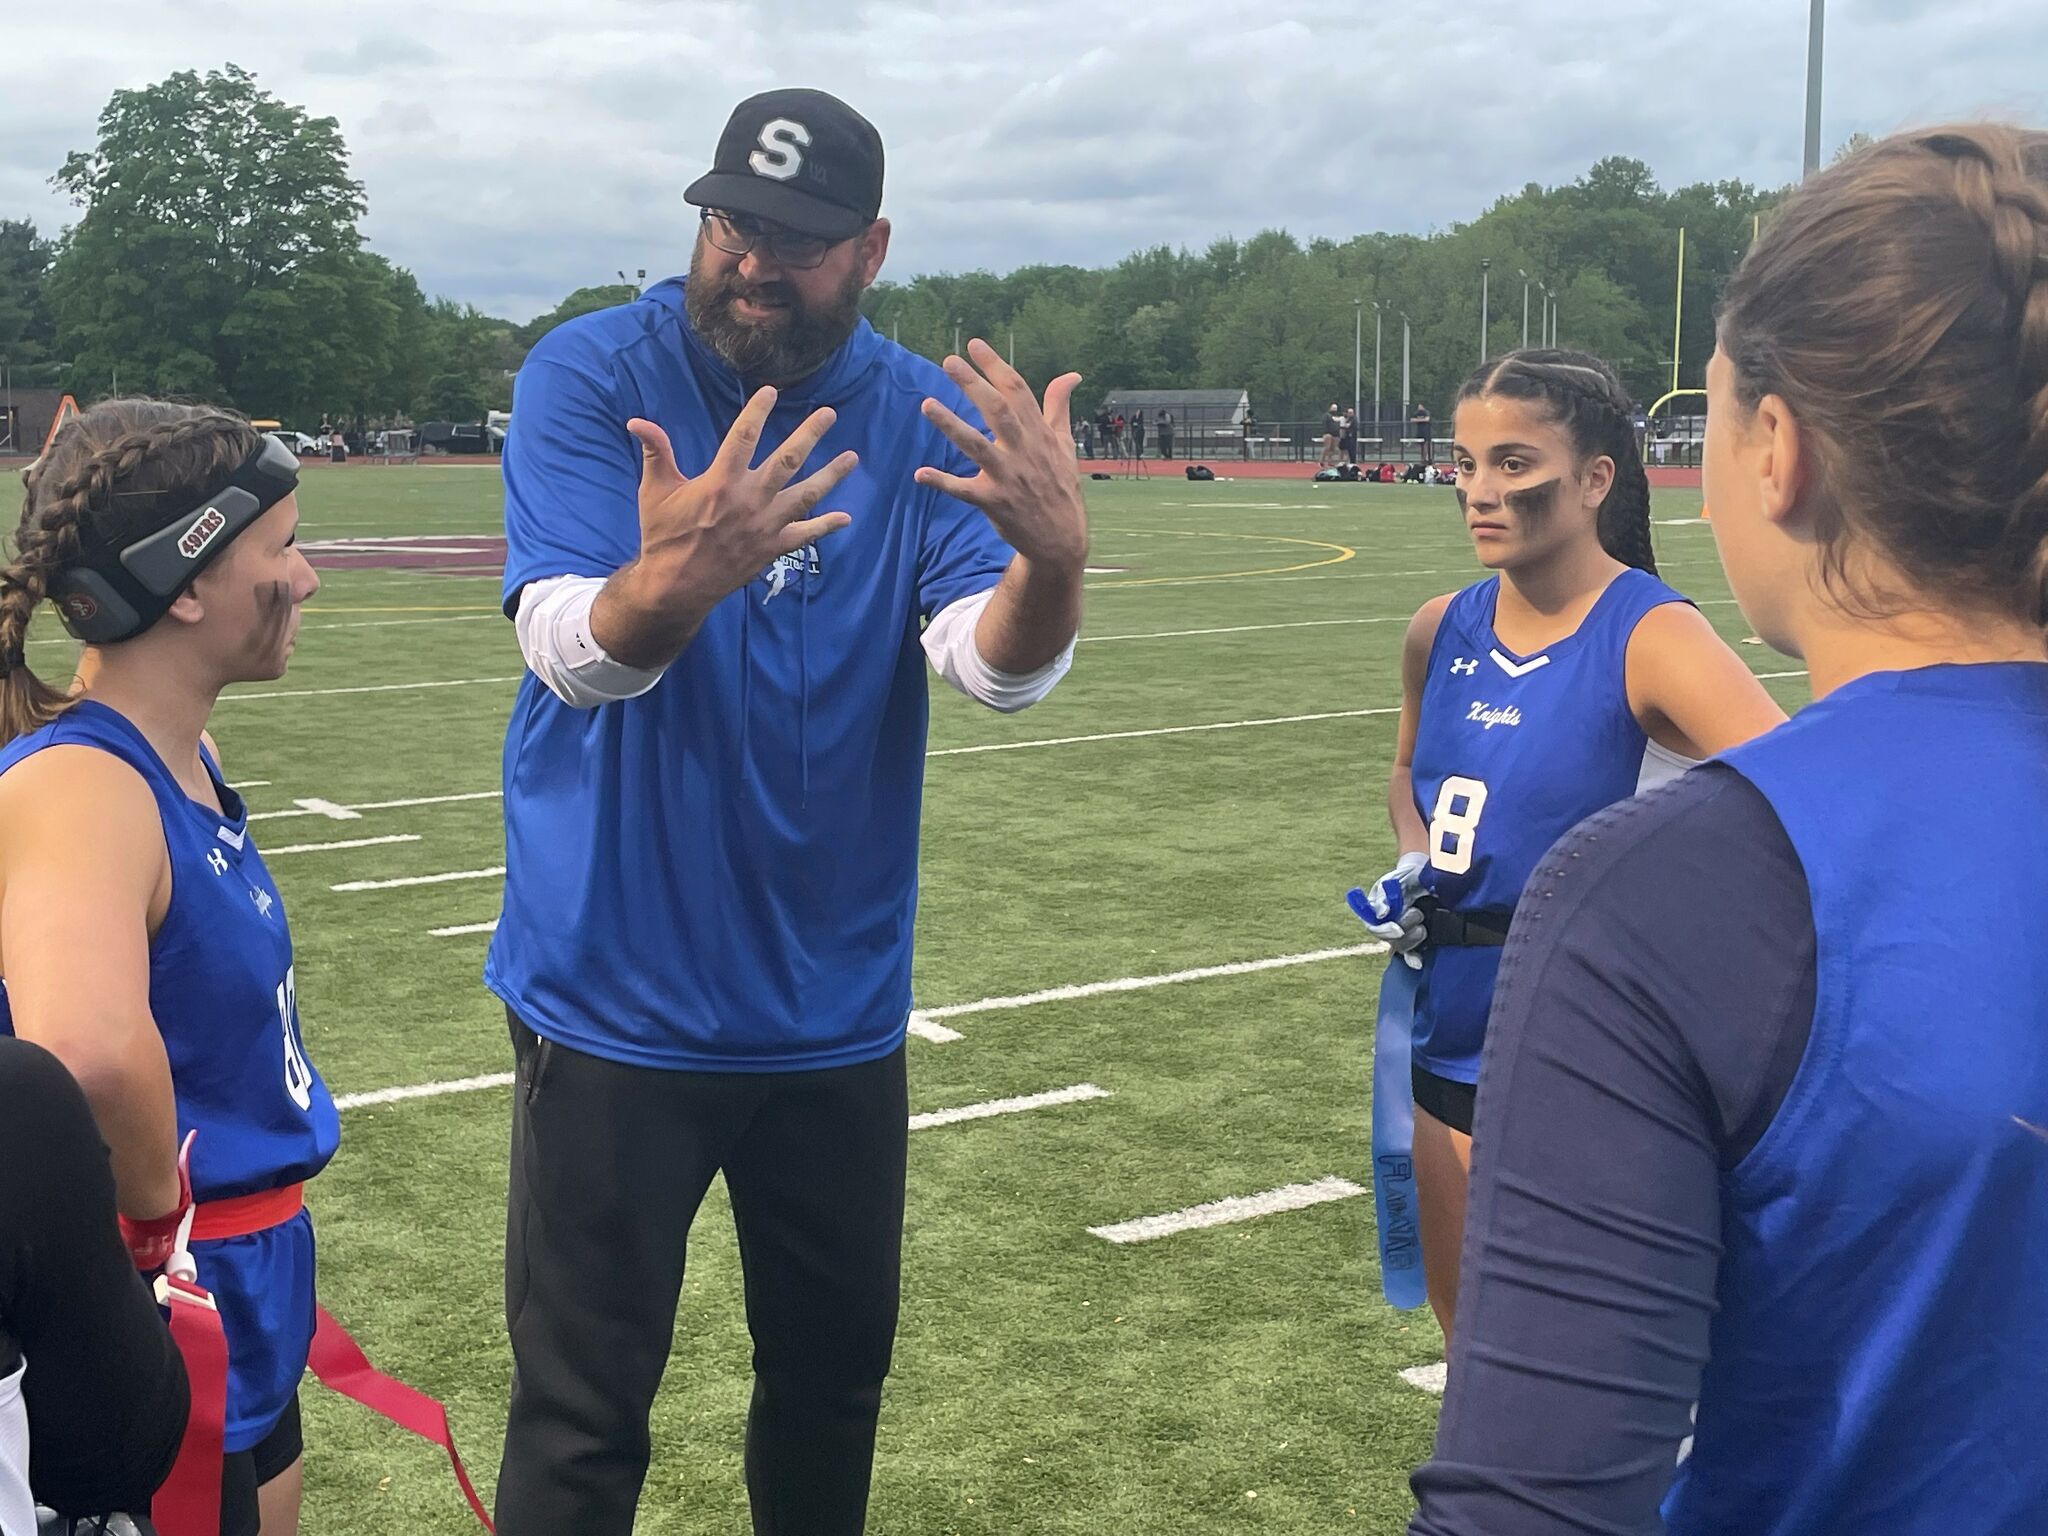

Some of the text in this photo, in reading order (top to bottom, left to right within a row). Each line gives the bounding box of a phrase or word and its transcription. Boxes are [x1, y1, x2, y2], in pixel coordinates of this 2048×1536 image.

[748, 118, 812, 181] S
[181, 510, 223, 555] 49ERS
[1466, 701, 1521, 730] Knights
[1430, 775, 1488, 875] 8
